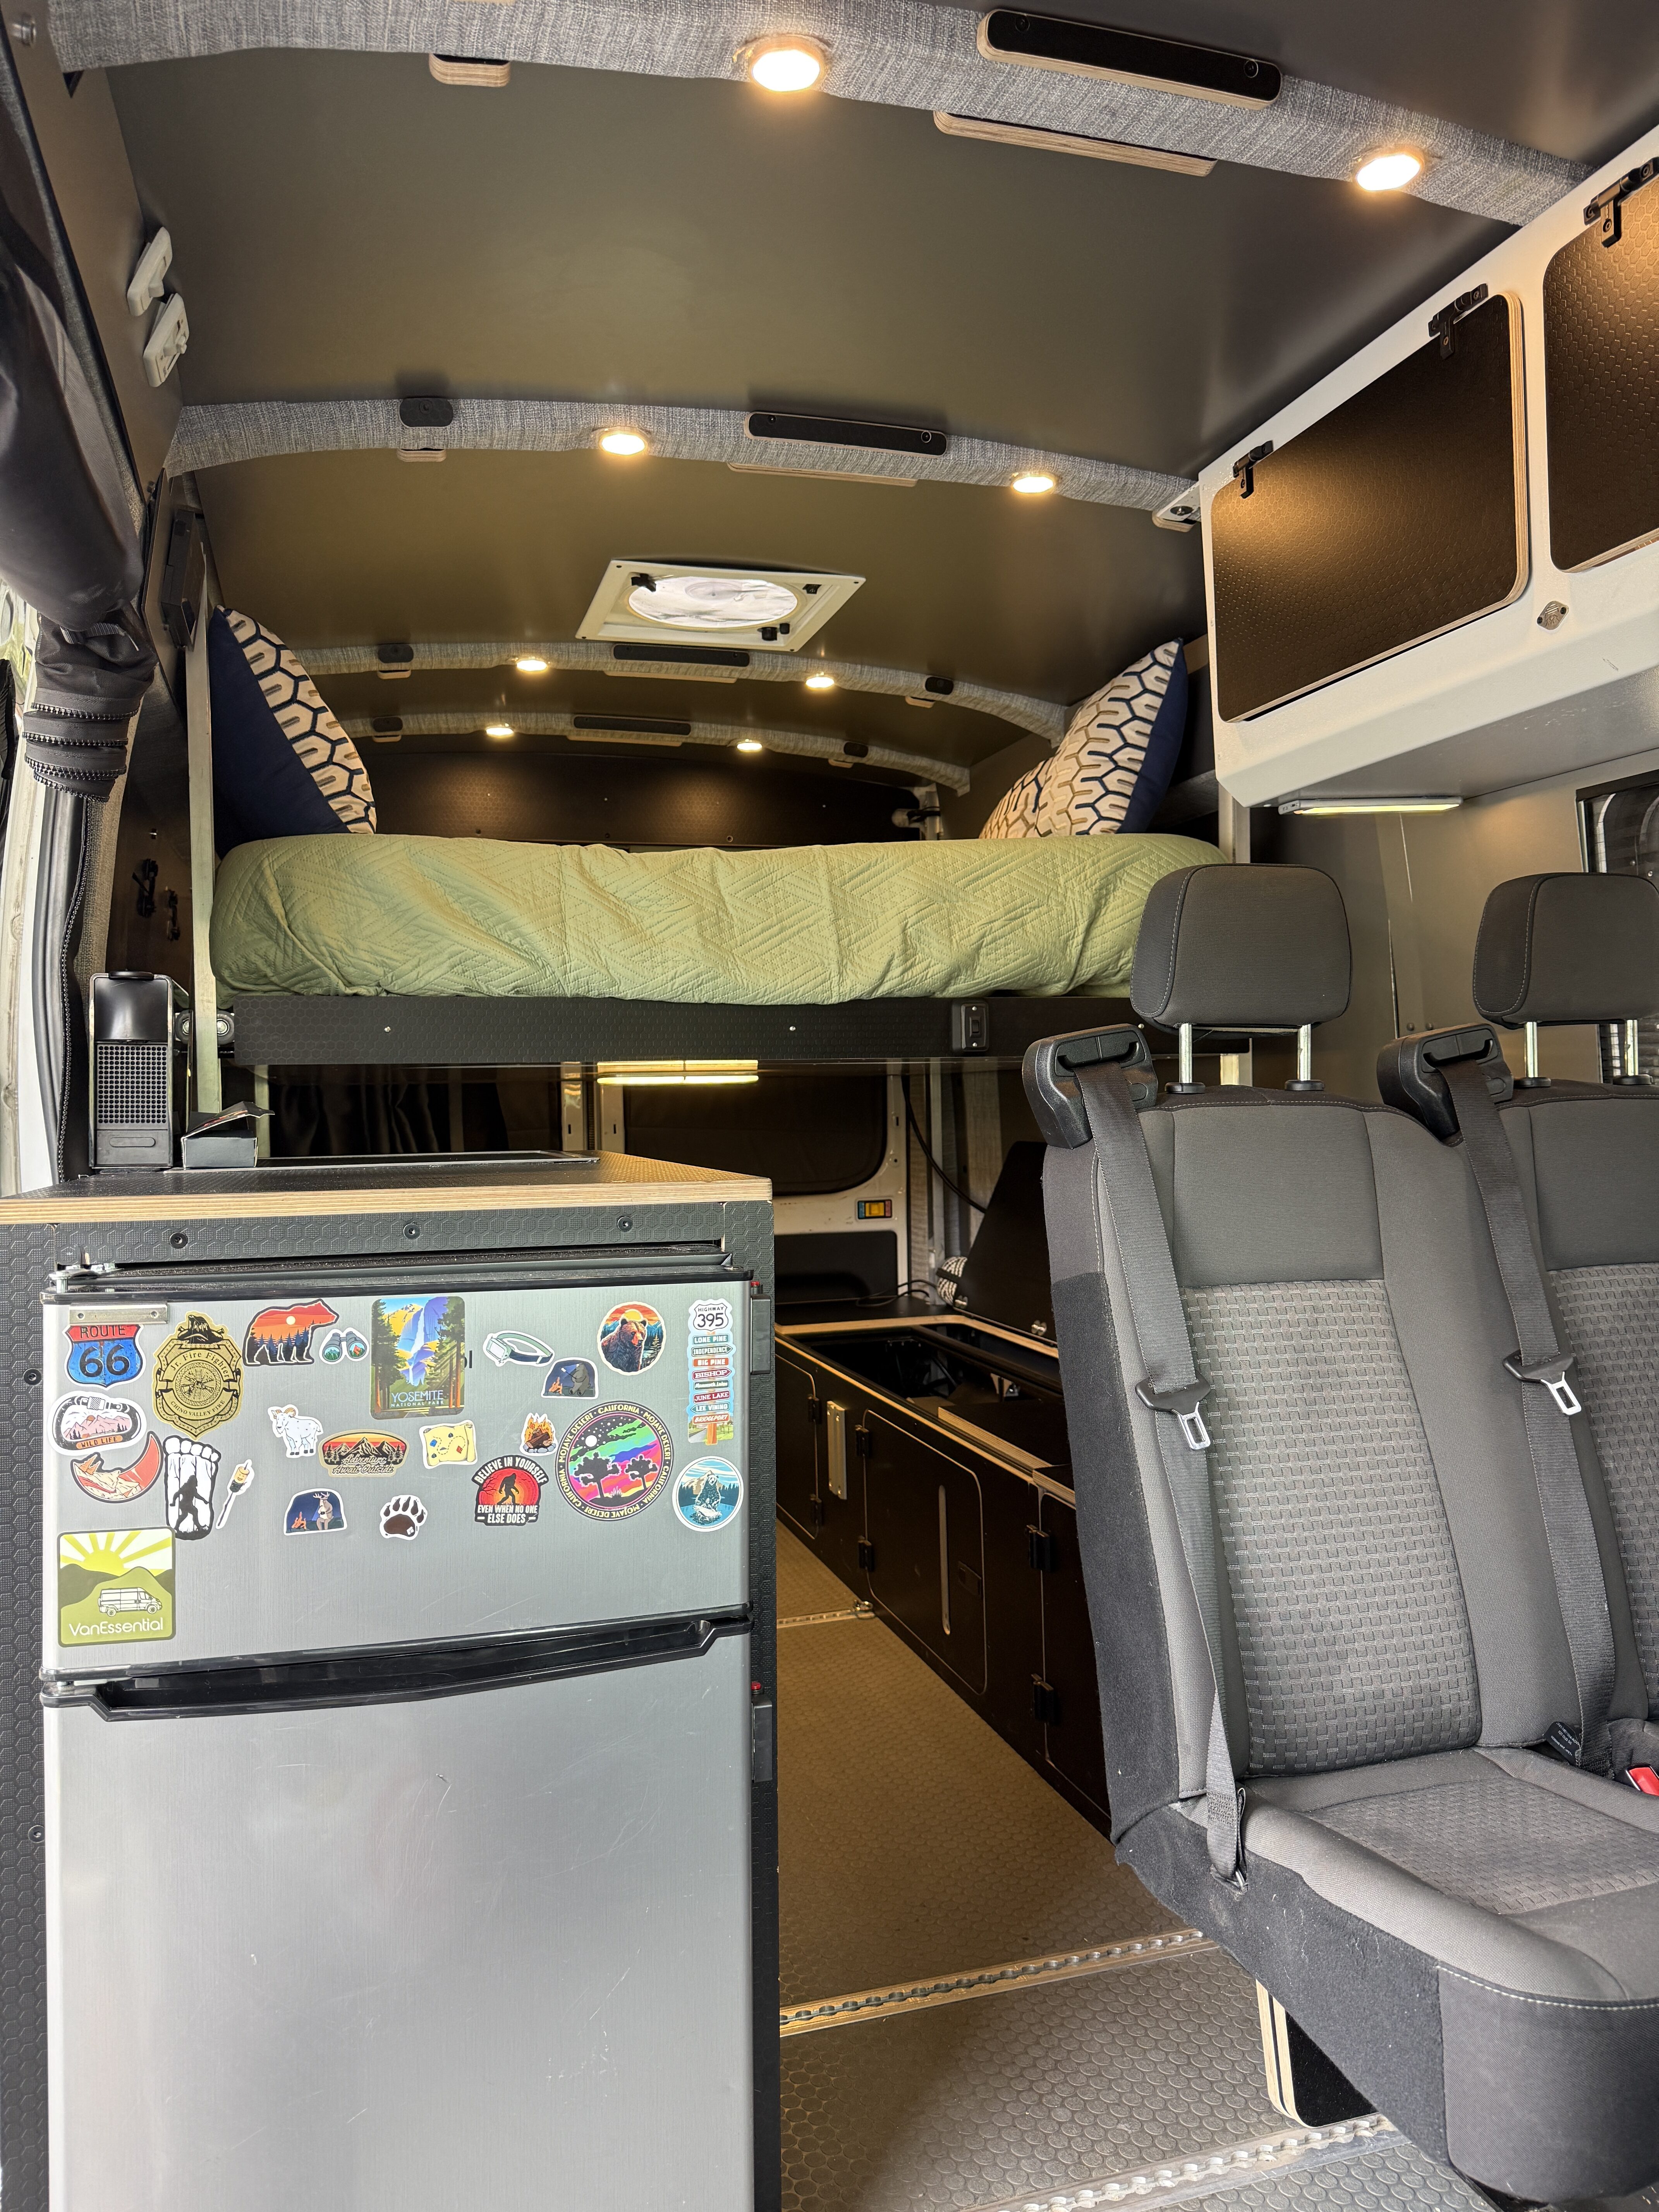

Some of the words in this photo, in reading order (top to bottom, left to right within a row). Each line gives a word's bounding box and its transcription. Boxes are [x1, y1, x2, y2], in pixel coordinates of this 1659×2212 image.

[697, 1313, 724, 1328] 395
[81, 1324, 126, 1338] ROUTE
[693, 1346, 728, 1355] INDEPENDENCE
[79, 1344, 131, 1377] 66
[171, 1360, 181, 1371] Jr.
[183, 1352, 202, 1361] Fire
[205, 1352, 230, 1378] Fighter
[695, 1369, 728, 1379] BISHOP
[391, 1389, 444, 1403] YOSEMITE
[171, 1401, 187, 1414] CHINO
[212, 1400, 225, 1413] FIRE
[598, 1404, 639, 1414] CALIFORNIA
[571, 1412, 594, 1434] DESERT
[643, 1412, 665, 1435] MOJAVE
[81, 1439, 98, 1448] WILD
[559, 1433, 574, 1463] MOJAVE
[661, 1435, 671, 1460] DESERT
[342, 1453, 387, 1464] Adventure
[333, 1464, 359, 1474] Await
[361, 1463, 394, 1474] Outside
[474, 1459, 503, 1484] BELIEVE
[503, 1457, 513, 1467] IN
[515, 1457, 547, 1484] YOURSELF
[560, 1468, 582, 1507] CALIFORNIA
[641, 1466, 669, 1504] CALIFORNIA
[477, 1505, 493, 1513] EVEN
[495, 1505, 514, 1513] WHEN
[515, 1505, 524, 1513] NO
[526, 1505, 538, 1513] ONE
[585, 1506, 610, 1518] DESERT
[611, 1503, 641, 1518] MOJAVE
[487, 1513, 505, 1523] ELSE
[506, 1513, 526, 1523] DOES
[69, 1617, 163, 1636] VanEssential
